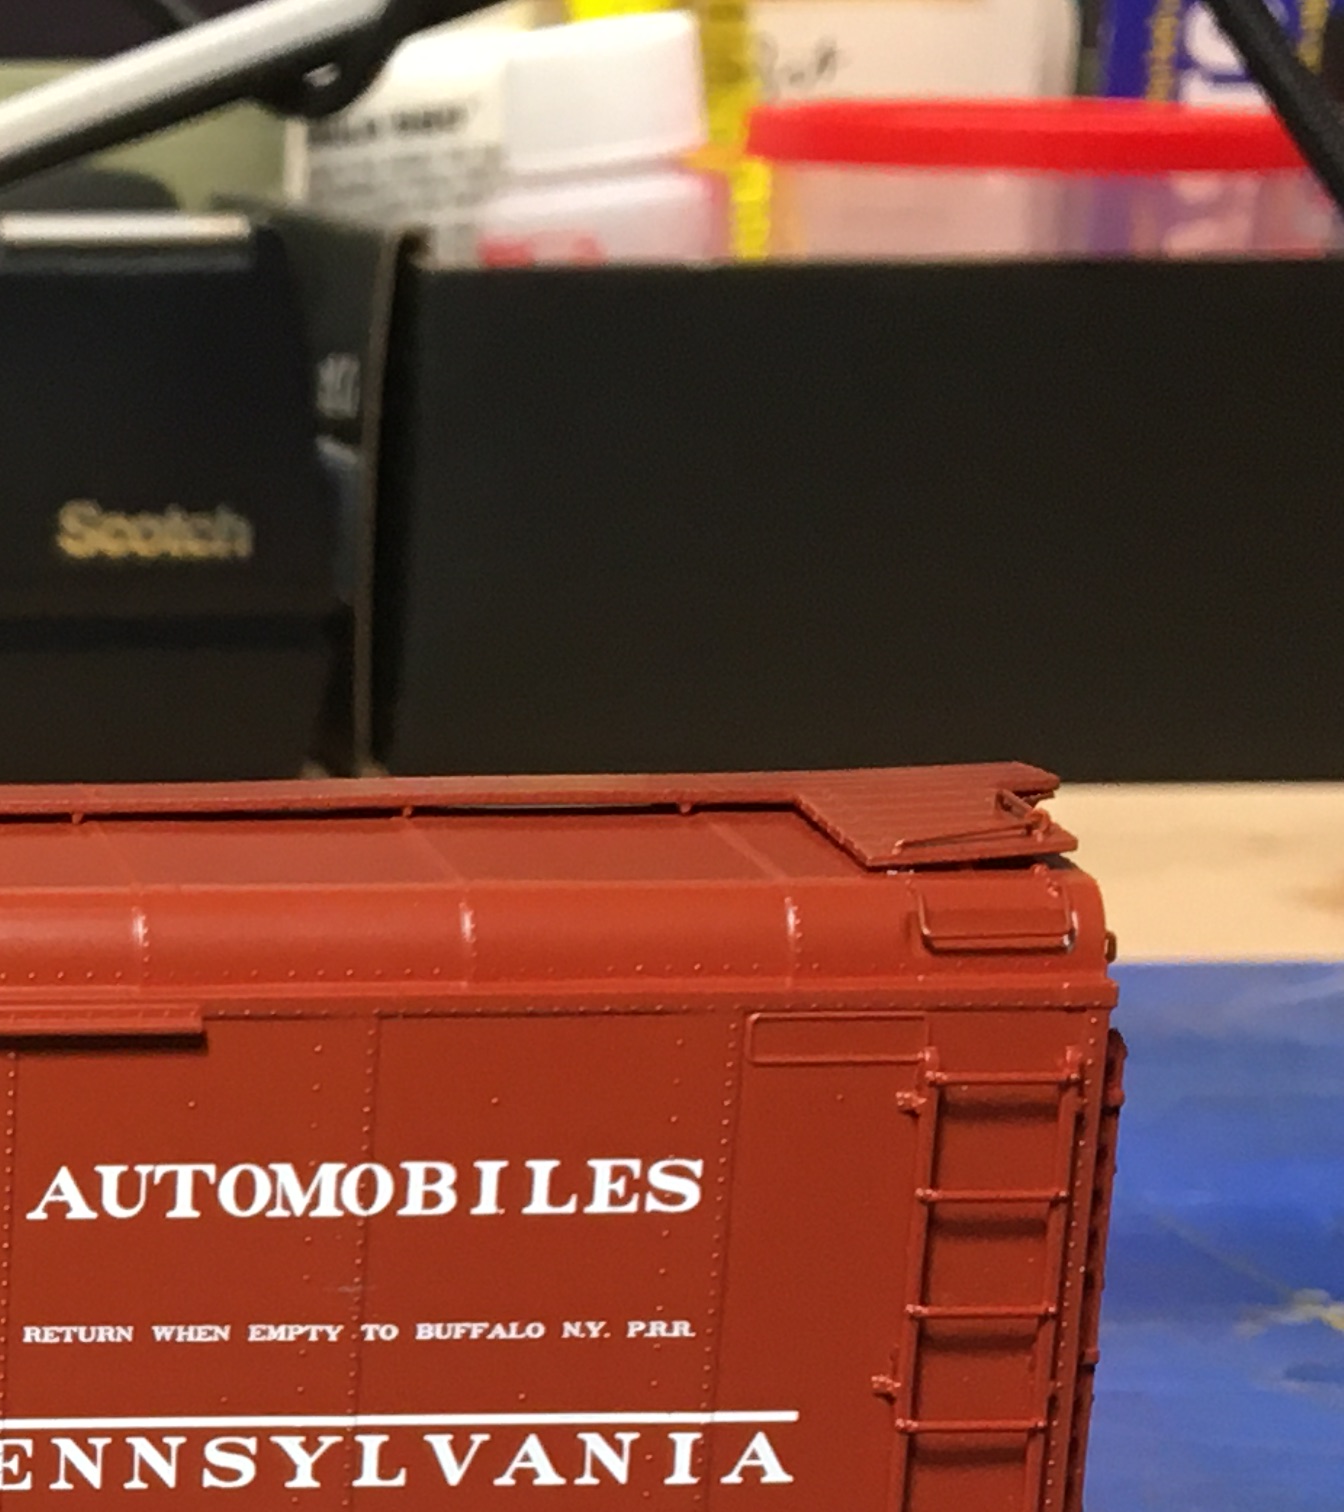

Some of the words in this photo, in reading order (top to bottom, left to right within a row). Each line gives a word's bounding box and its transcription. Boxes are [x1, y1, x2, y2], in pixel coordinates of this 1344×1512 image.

[58, 499, 253, 559] Scotch
[26, 1158, 703, 1220] AUTOMOBILES
[23, 1326, 133, 1343] RETURN
[152, 1325, 230, 1342] WHEN
[248, 1324, 344, 1342] EMPTY
[361, 1324, 399, 1341] TO
[415, 1322, 545, 1340] BUFFALO
